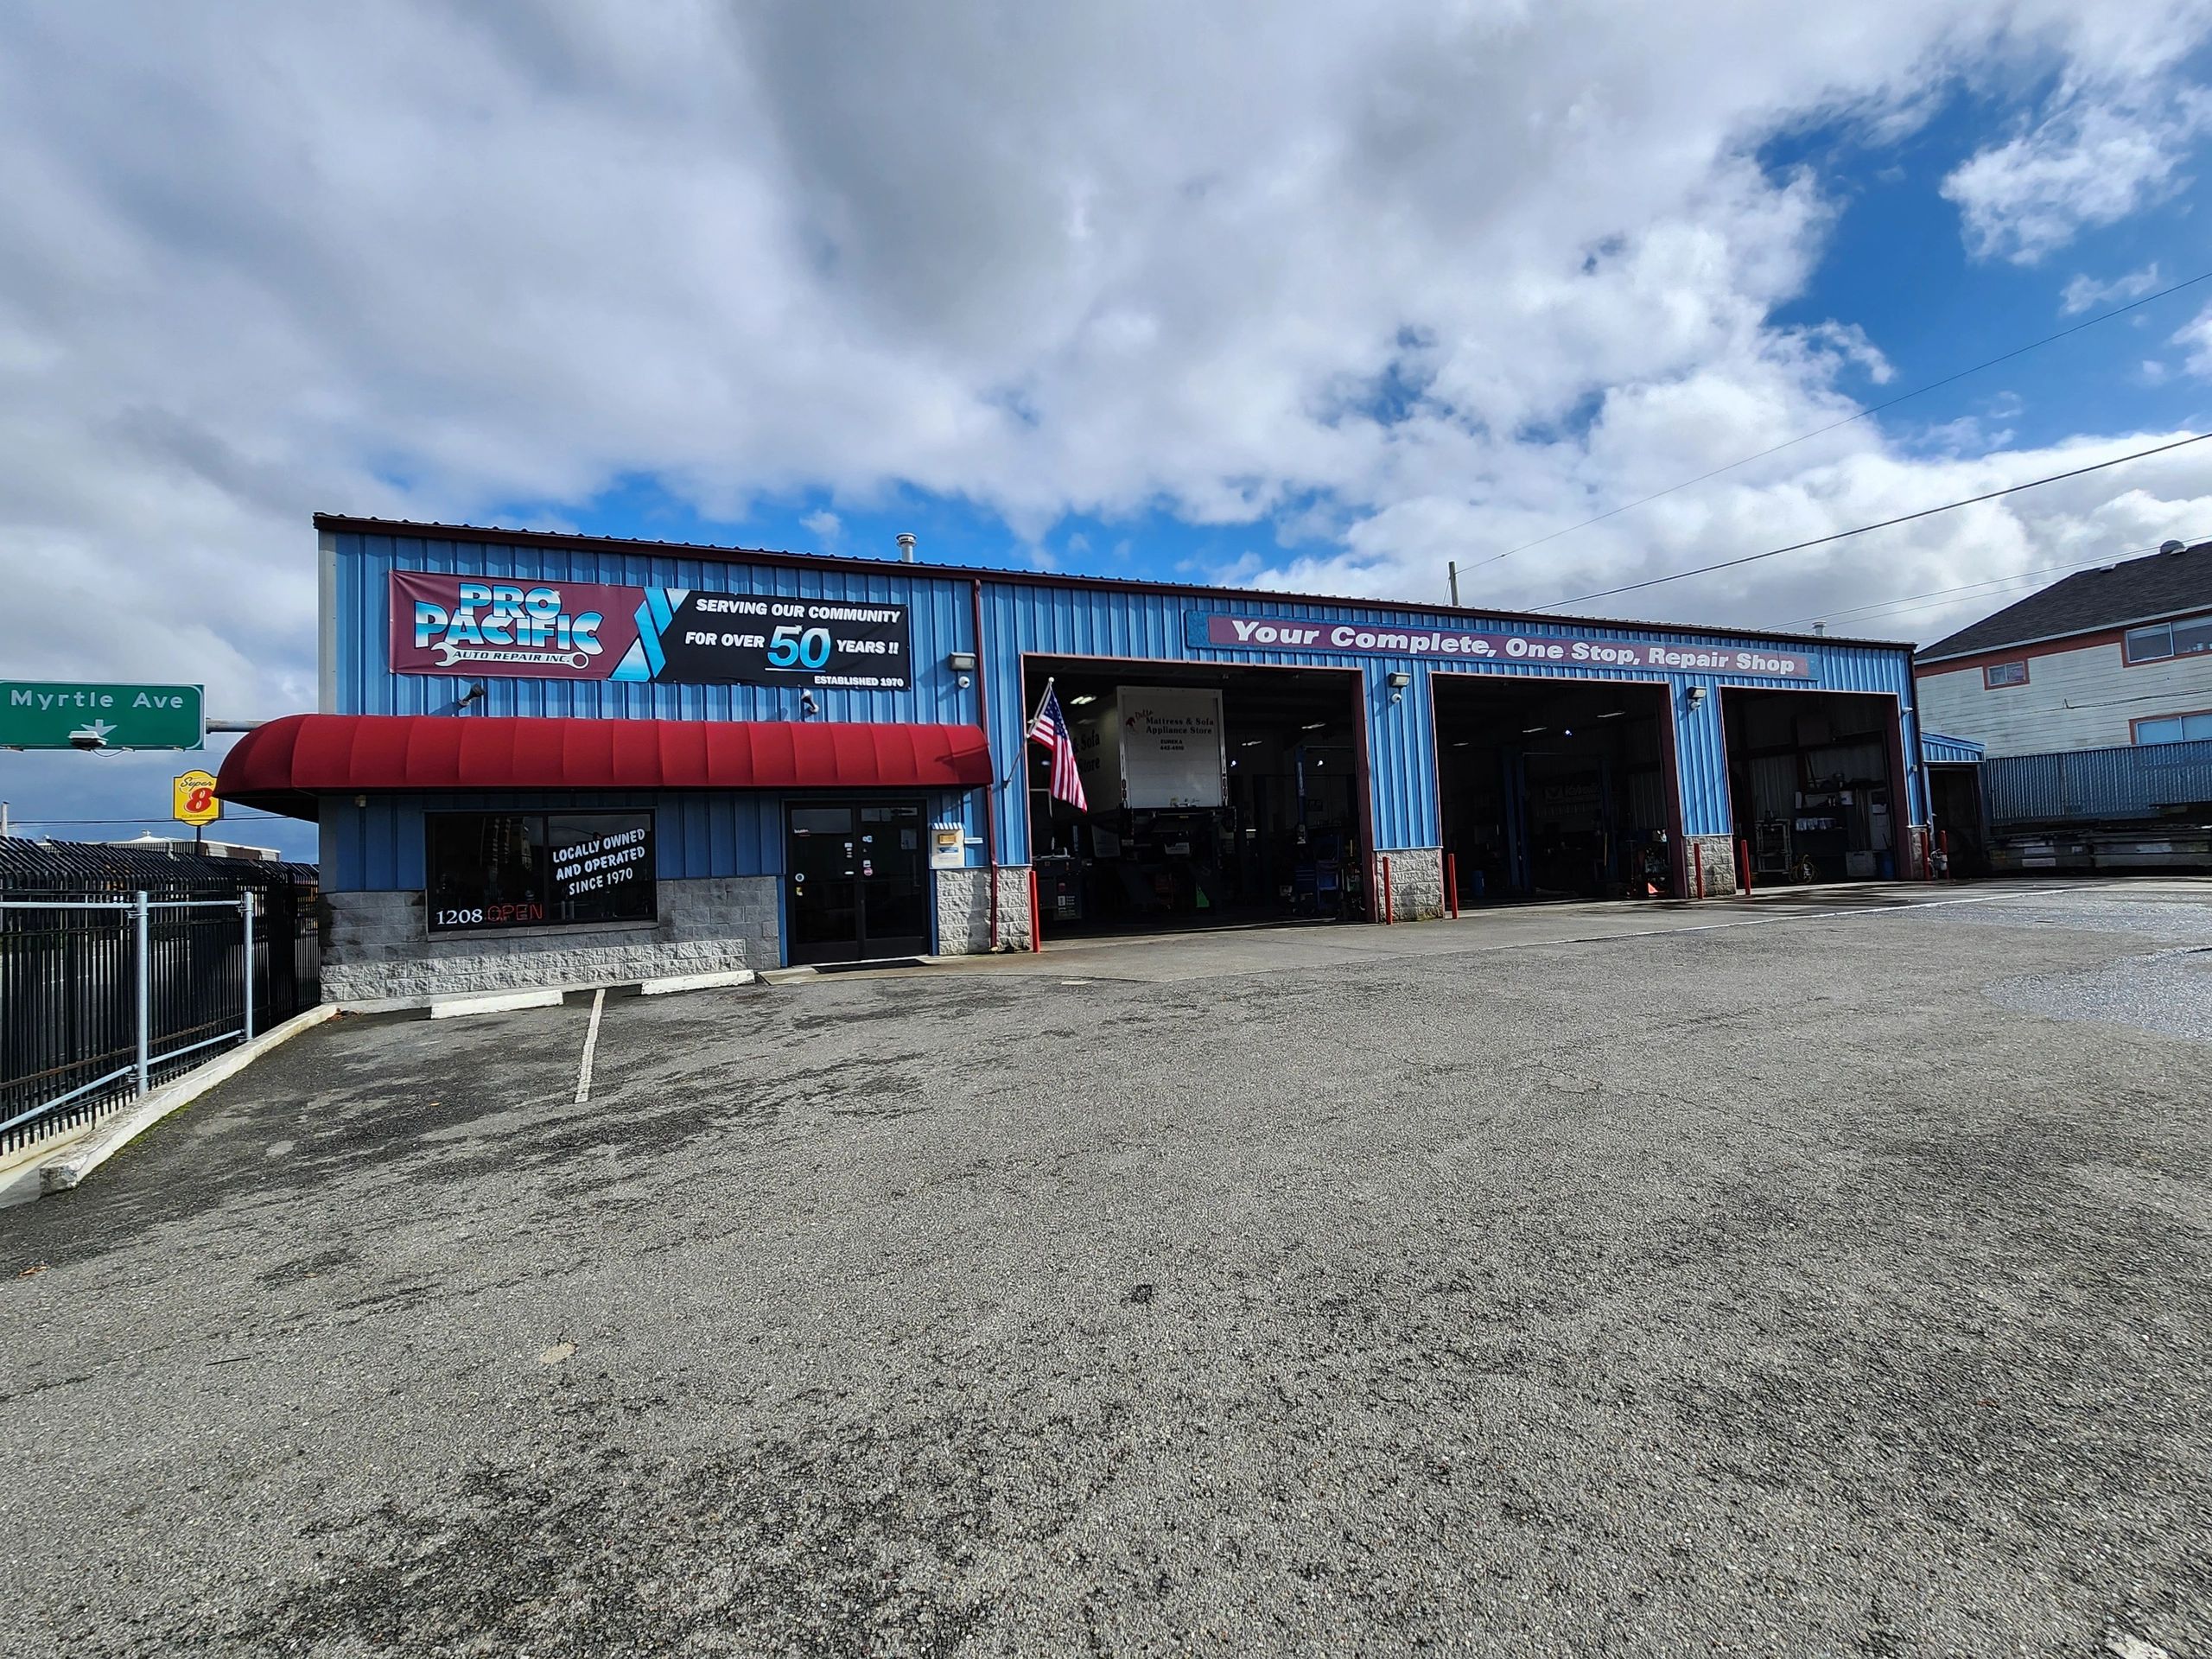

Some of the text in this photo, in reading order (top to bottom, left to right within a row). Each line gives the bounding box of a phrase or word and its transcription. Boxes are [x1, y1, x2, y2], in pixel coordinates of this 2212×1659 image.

[459, 582, 562, 620] PRO
[696, 598, 900, 623] SERVING OUR COMMUNITY
[415, 600, 604, 655] PACIFIC
[452, 650, 570, 663] AUTO REPAIR INC.
[685, 632, 717, 645] FOR
[721, 632, 765, 648] OVER
[767, 624, 831, 668] 50
[836, 639, 885, 654] YEARS
[1232, 620, 1795, 675] Your Complete, One Stop, Repair Shop
[814, 676, 904, 687] ESTABLISHED 1970
[10, 690, 184, 710] Myrtle Ave
[1081, 730, 1100, 751] Sofa
[1146, 726, 1187, 734] Appliance
[180, 776, 214, 792] Super
[183, 787, 213, 813] 8
[552, 828, 645, 863] LOCALLY OWNED
[556, 845, 645, 881] AND OPERATED
[569, 867, 633, 896] SINCE 1970
[435, 908, 483, 925] 1208
[486, 903, 543, 924] OPEN
